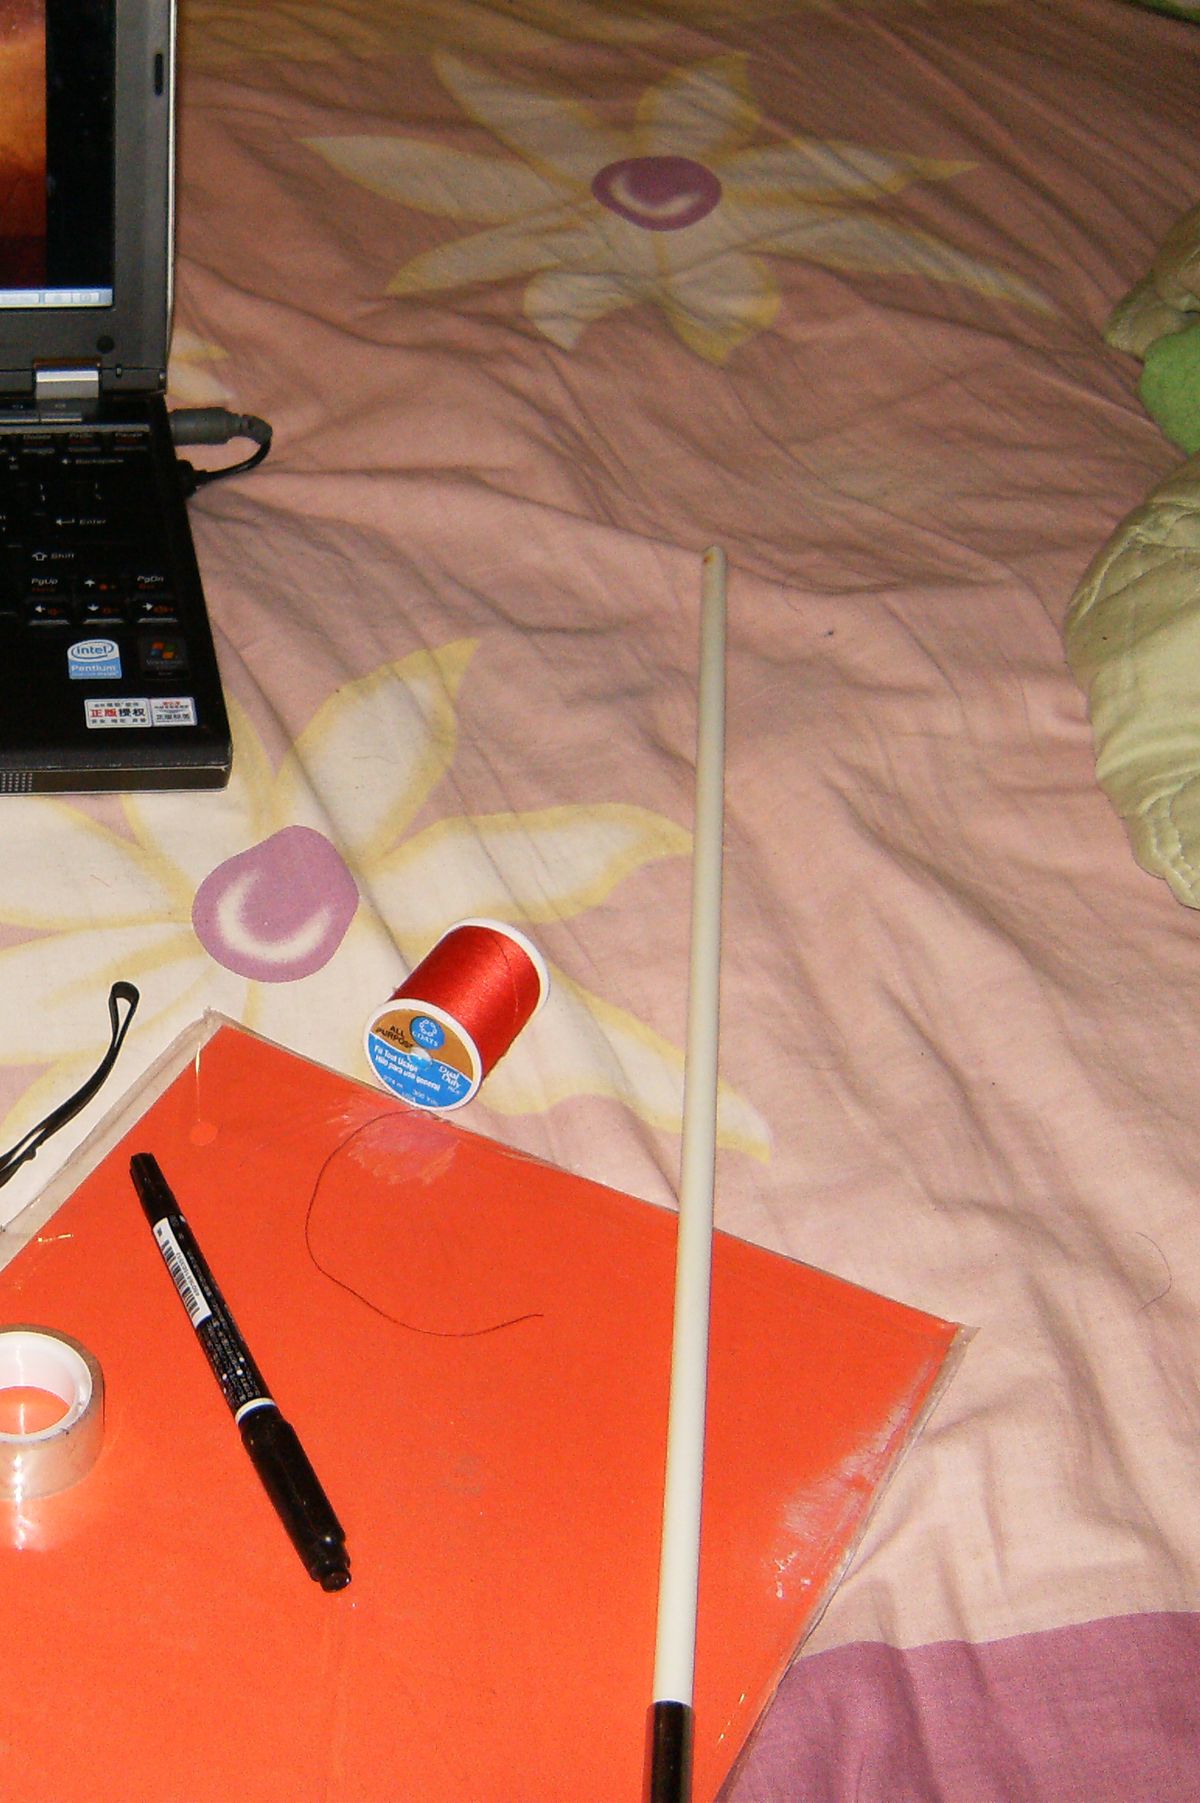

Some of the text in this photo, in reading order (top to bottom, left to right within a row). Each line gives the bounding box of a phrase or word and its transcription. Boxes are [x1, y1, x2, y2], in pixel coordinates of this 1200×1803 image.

[31, 577, 59, 586] PgUp
[76, 644, 109, 656] intel
[71, 664, 117, 673] Pentium
[89, 707, 147, 719] 正版授权
[389, 1025, 405, 1038] ALL
[412, 1030, 439, 1047] COATS
[438, 1065, 460, 1081] Dual
[441, 1073, 462, 1089] Duty
